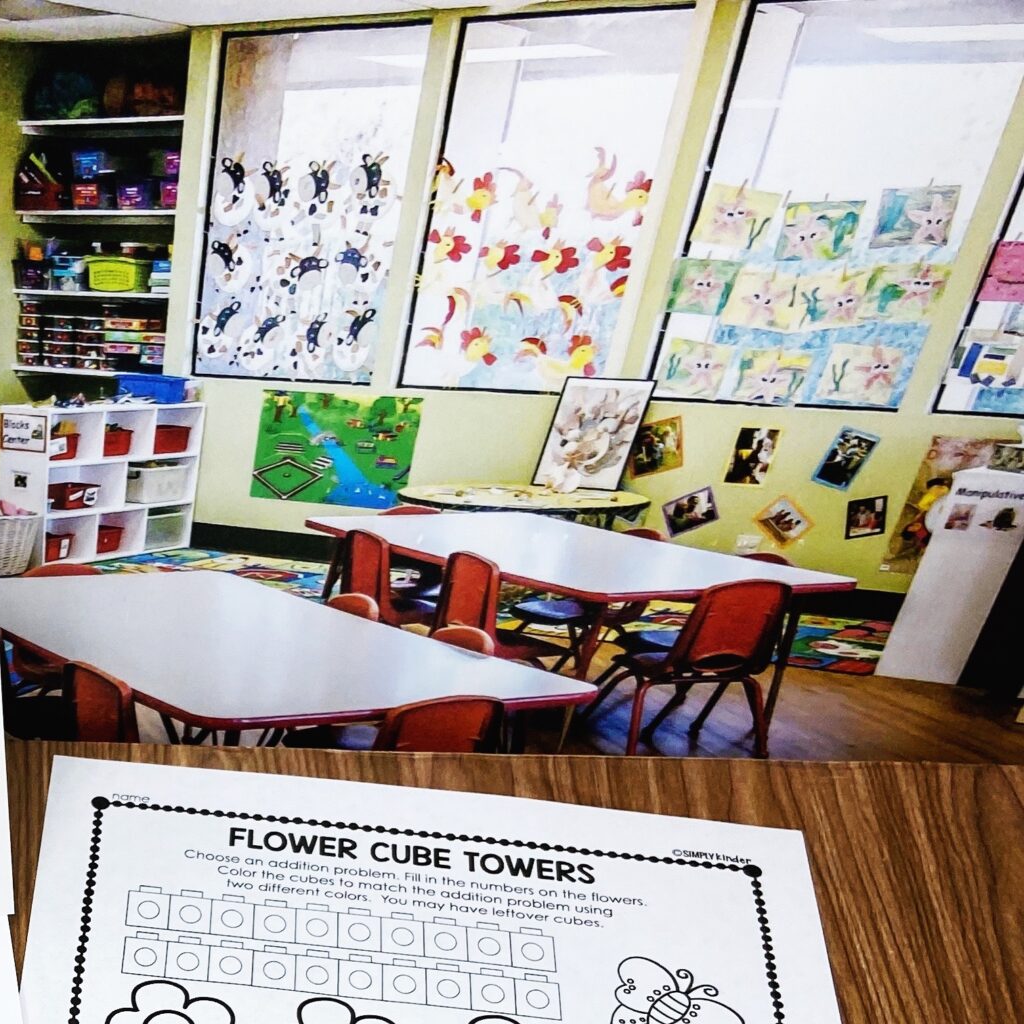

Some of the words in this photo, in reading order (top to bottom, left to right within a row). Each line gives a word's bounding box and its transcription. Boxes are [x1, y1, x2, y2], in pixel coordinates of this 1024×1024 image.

[2, 434, 31, 444] Center
[3, 419, 30, 430] Blocks
[112, 793, 151, 803] name
[183, 849, 241, 864] Choose
[244, 857, 264, 866] an
[267, 860, 329, 873] addition
[333, 866, 400, 880] problem.
[404, 871, 421, 883] Fill
[425, 875, 437, 885] in
[442, 876, 466, 888] the
[470, 881, 535, 896] numbers
[538, 888, 558, 898] on
[562, 889, 587, 901] the
[591, 892, 647, 907] flowers.
[229, 827, 358, 860] FLOWER
[370, 842, 451, 870] CUBE
[463, 851, 595, 884] TOWERS
[217, 865, 257, 878] Color
[261, 869, 285, 881] the
[289, 874, 335, 886] cubes
[339, 877, 354, 888] to
[358, 881, 407, 894] match
[412, 885, 436, 897] the
[440, 890, 503, 905] addition
[507, 898, 570, 912] problem
[574, 904, 614, 918] using
[226, 878, 254, 890] two
[258, 882, 320, 897] different
[324, 889, 372, 902] colors.
[380, 894, 408, 906] You
[412, 899, 446, 912] may
[449, 902, 488, 916] have
[492, 907, 550, 922] leftover
[553, 914, 605, 928] cubes.
